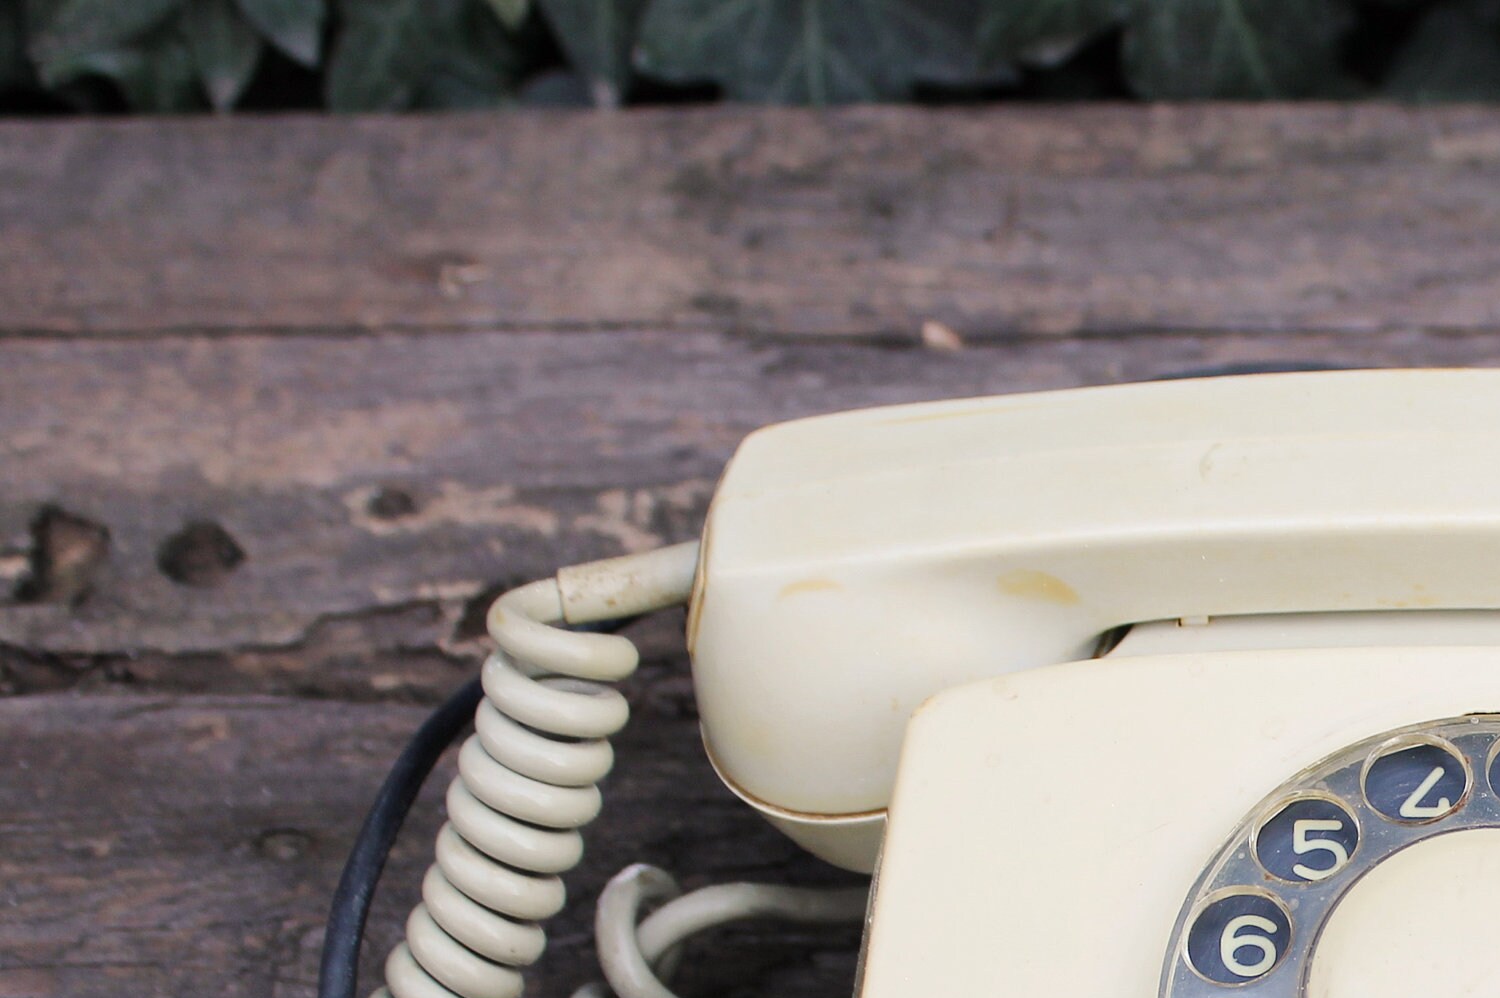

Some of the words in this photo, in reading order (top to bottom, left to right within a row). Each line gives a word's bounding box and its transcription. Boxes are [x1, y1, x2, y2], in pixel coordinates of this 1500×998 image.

[1400, 766, 1451, 818] 4
[1293, 819, 1349, 881] 5
[1220, 914, 1278, 977] 6
